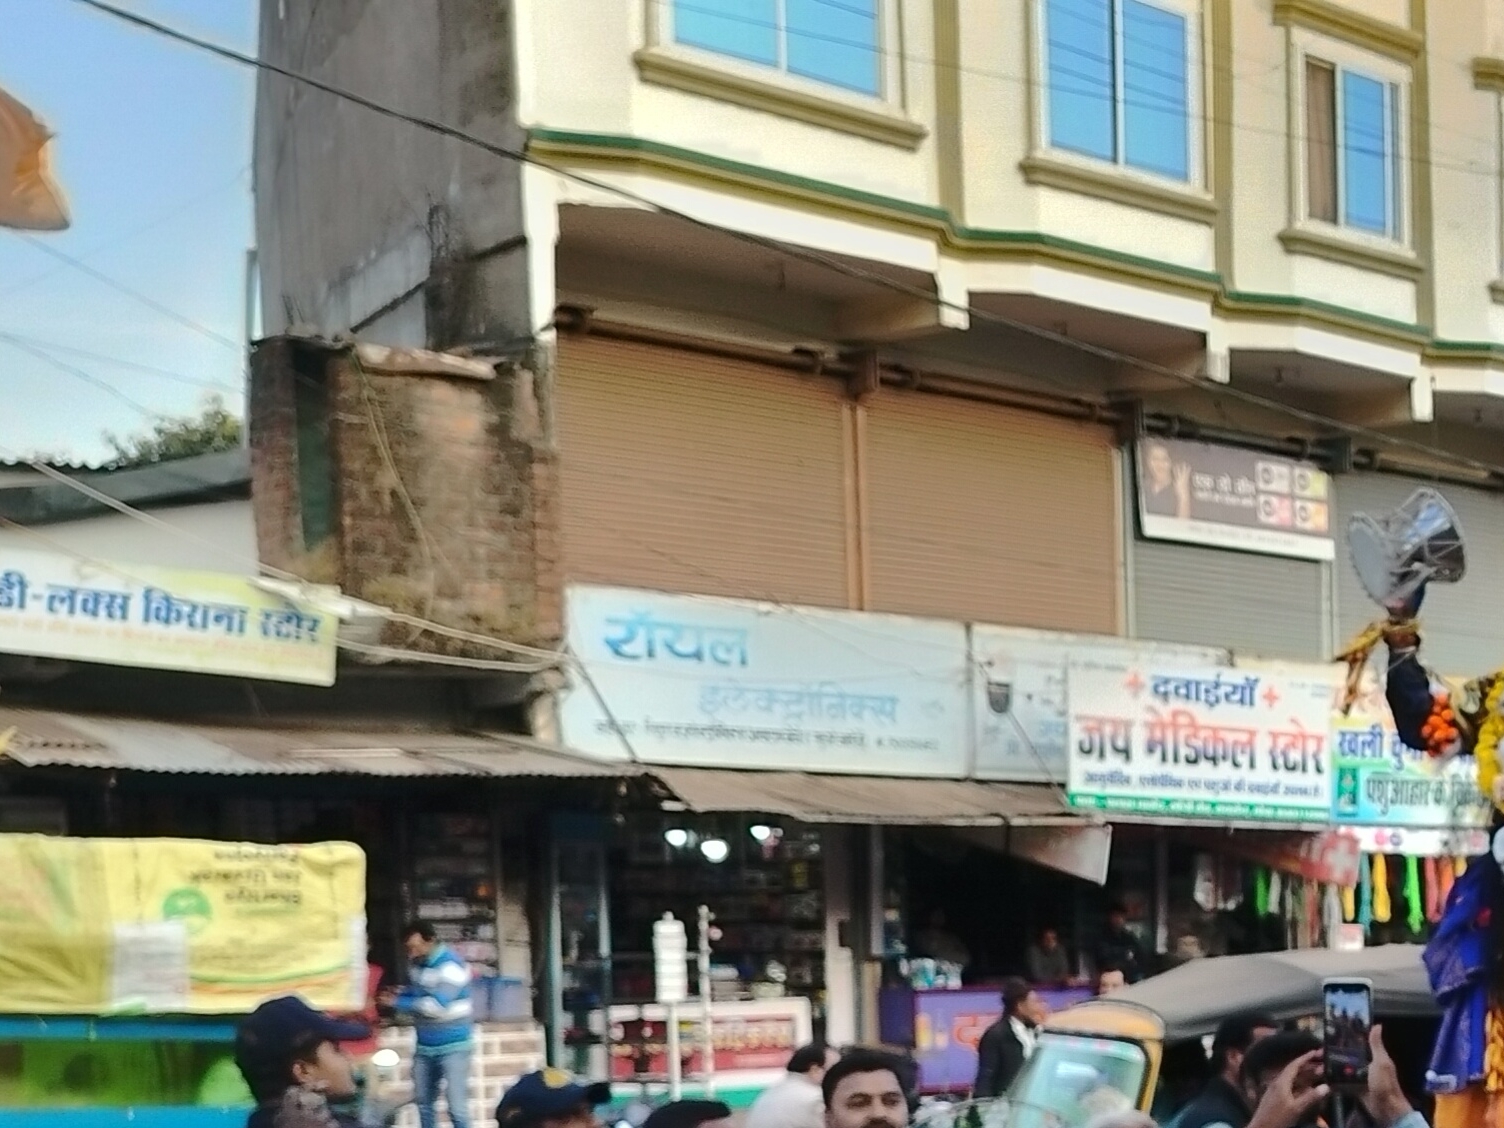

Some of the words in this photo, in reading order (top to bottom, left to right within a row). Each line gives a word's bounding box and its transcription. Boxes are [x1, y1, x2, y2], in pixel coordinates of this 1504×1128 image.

[142, 586, 249, 636] किराना
[260, 602, 322, 643] स्टोर
[603, 608, 749, 667] रॉयल
[1075, 714, 1135, 762] जय
[1143, 705, 1258, 769] मेडिकल
[1268, 716, 1327, 774] स्टोर
[1339, 723, 1383, 758] खली
